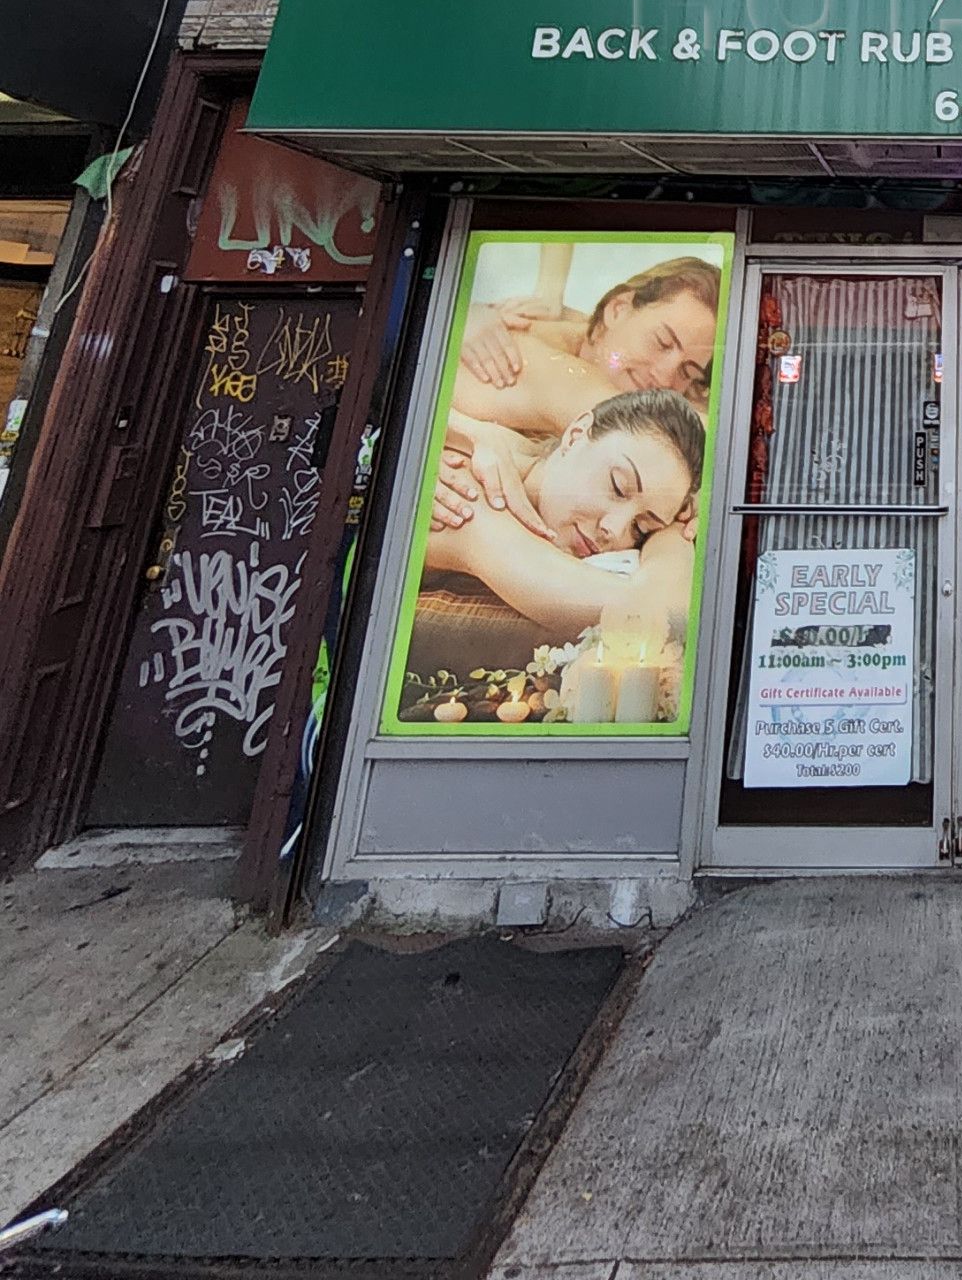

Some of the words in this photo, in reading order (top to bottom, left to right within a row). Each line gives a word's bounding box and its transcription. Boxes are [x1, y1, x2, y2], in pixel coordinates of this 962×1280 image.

[531, 27, 658, 60] BACK
[672, 29, 701, 60] &
[718, 30, 846, 63] FOOT
[861, 31, 954, 63] RUB
[915, 436, 924, 481] PUSH
[791, 564, 883, 588] EARLY
[775, 591, 896, 616] SPECIAL
[758, 655, 825, 669] 11:00am
[846, 653, 906, 669] 3:00pm
[760, 688, 783, 700] Gift
[786, 687, 845, 699] Certificate
[850, 686, 902, 699] Available
[755, 720, 821, 735] Purchase
[838, 719, 866, 733] Gift
[869, 718, 904, 733] Cert.
[867, 742, 896, 757] cert
